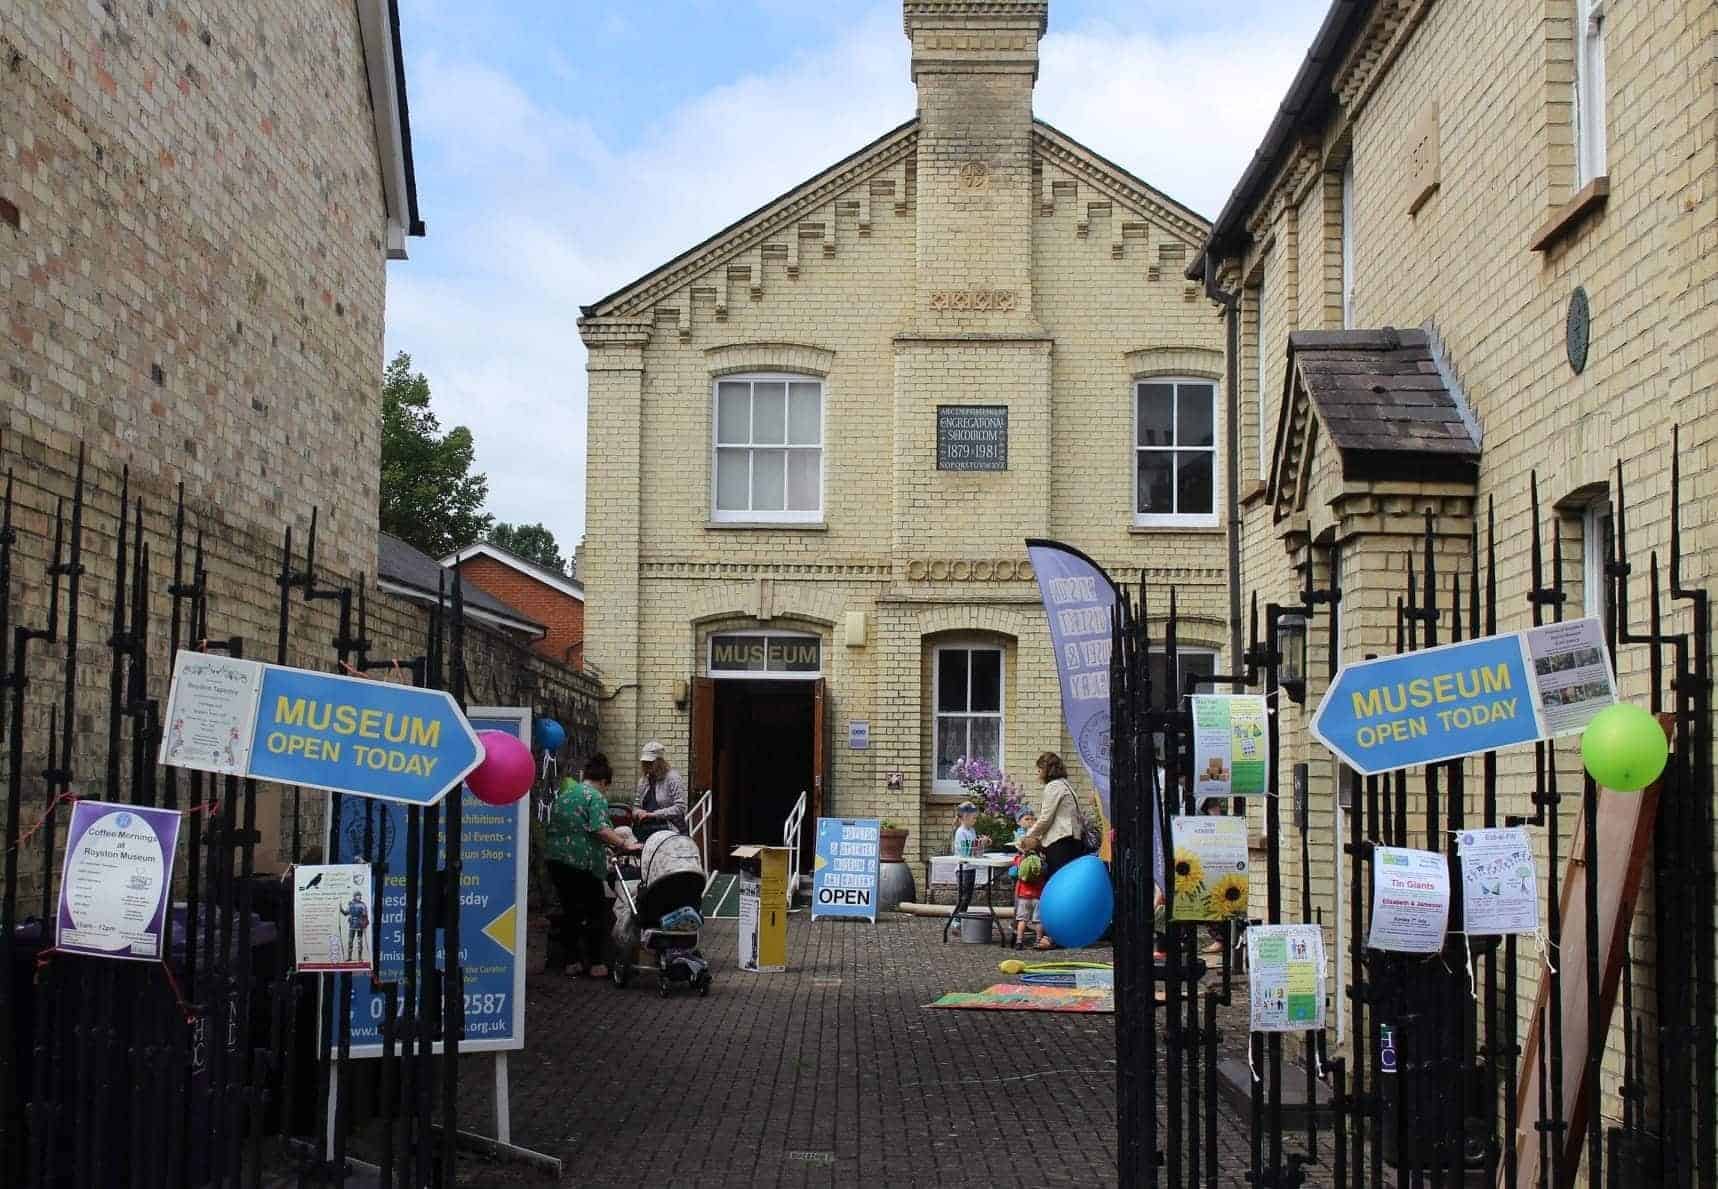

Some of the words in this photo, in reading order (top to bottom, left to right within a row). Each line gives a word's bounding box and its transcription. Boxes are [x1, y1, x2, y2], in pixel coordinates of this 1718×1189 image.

[715, 644, 817, 664] MUSEUM
[1352, 663, 1512, 719] MUSEUM
[274, 695, 440, 748] MUSEUM
[1357, 716, 1428, 748] OPEN
[1437, 697, 1518, 732] TODAY
[267, 732, 341, 762] OPEN
[352, 744, 438, 777] TODAY
[88, 826, 117, 838] Coffee
[474, 831, 505, 843] Events
[120, 851, 157, 864] Museum
[480, 851, 505, 863] Shop
[1392, 879, 1405, 889] Tin
[1406, 880, 1436, 891] Giants
[818, 888, 871, 905] OPEN
